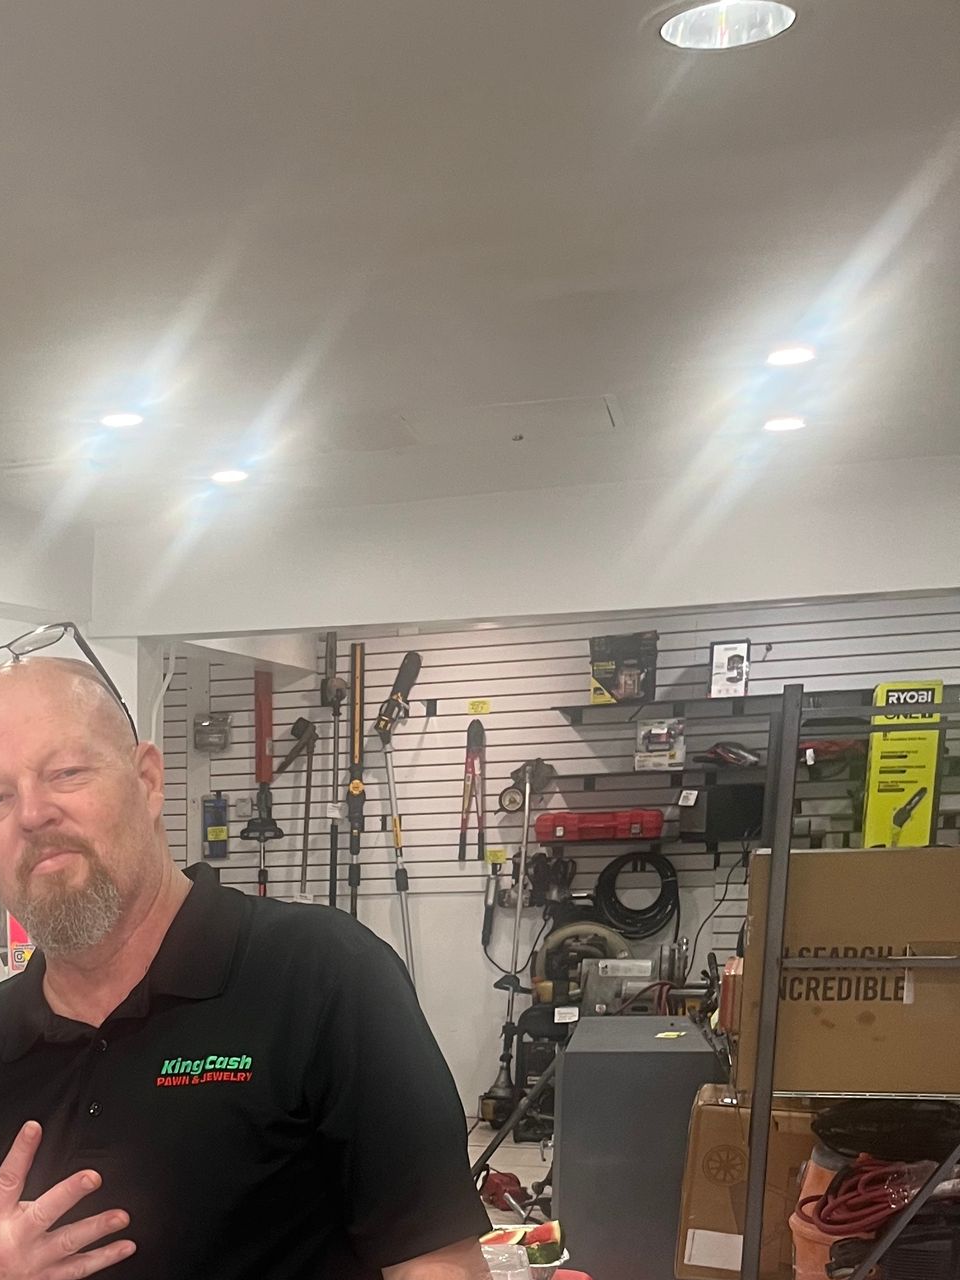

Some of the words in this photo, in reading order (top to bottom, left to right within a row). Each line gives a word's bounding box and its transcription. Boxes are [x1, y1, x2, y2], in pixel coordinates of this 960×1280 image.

[888, 690, 932, 704] RYOBI
[778, 976, 906, 1001] NCREDIBLE
[161, 1058, 204, 1075] King
[205, 1055, 252, 1070] Cash
[156, 1075, 189, 1087] PAWN
[191, 1075, 200, 1085] &
[200, 1071, 253, 1083] JEWELRY
